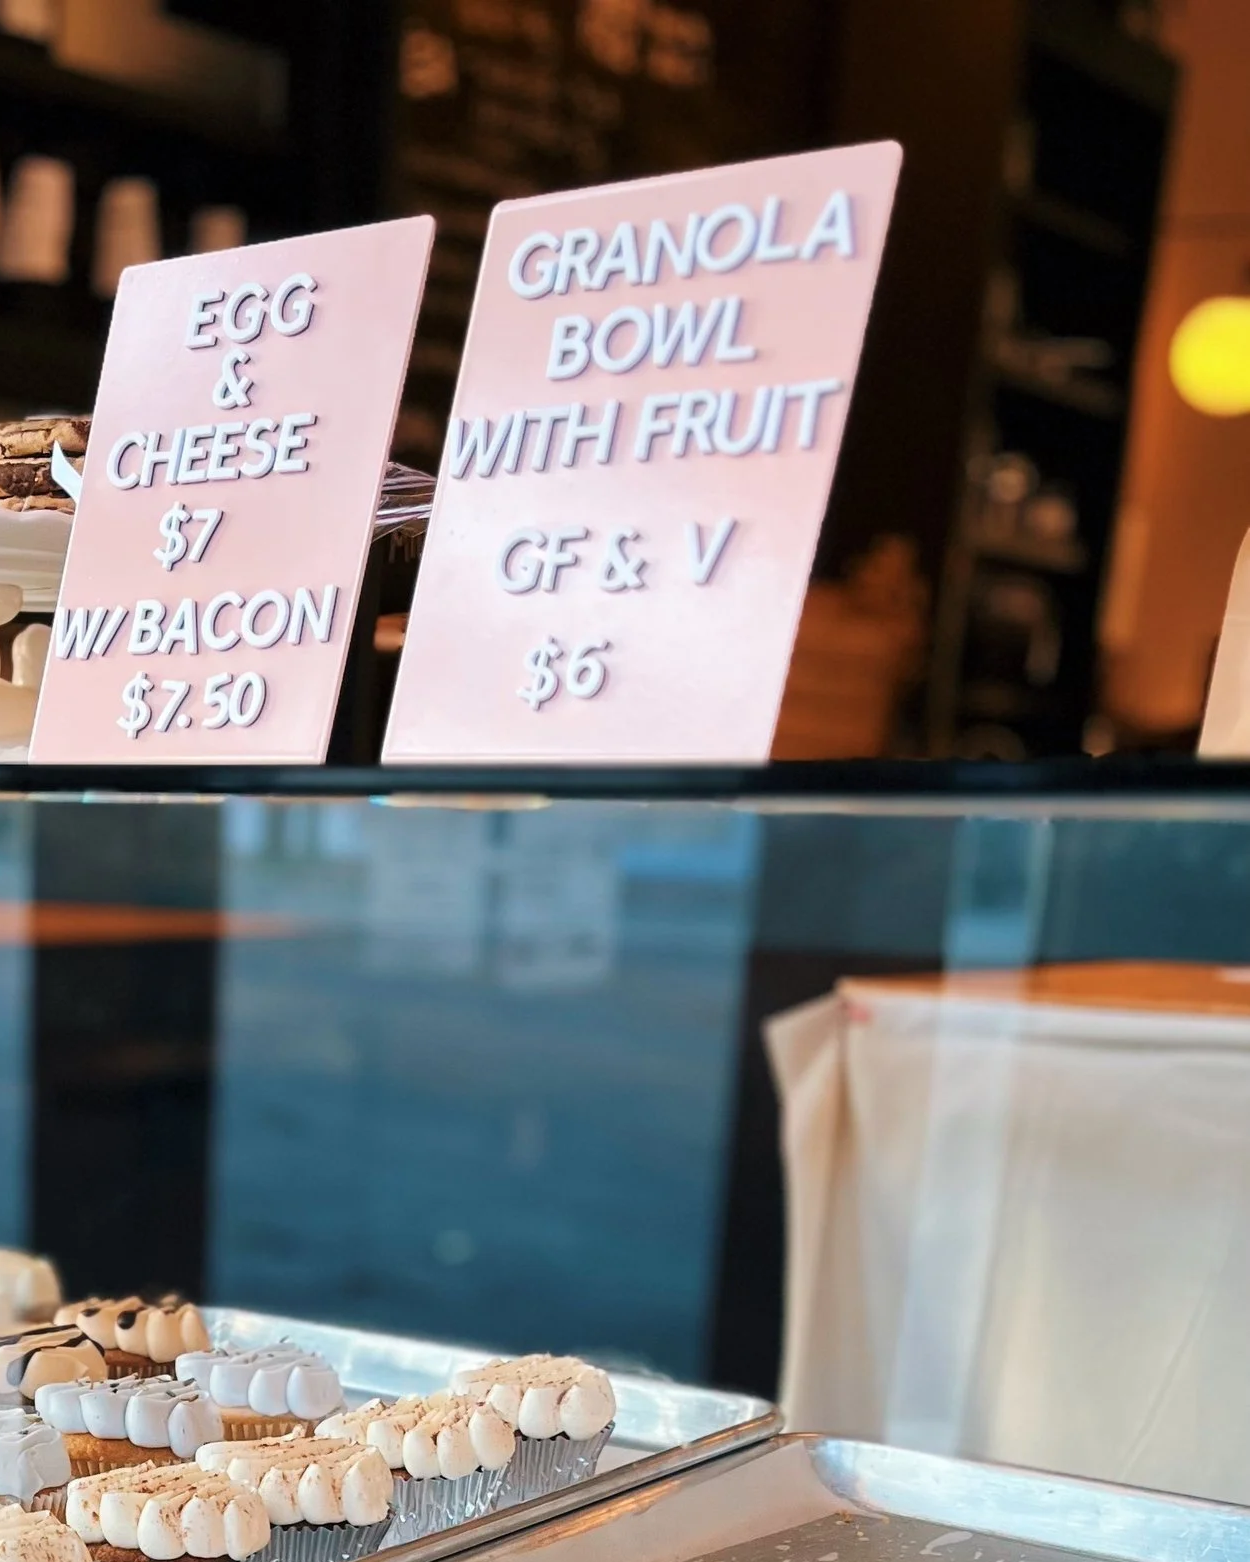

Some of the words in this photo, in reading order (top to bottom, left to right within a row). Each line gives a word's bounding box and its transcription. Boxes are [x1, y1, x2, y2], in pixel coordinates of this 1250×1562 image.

[507, 191, 856, 300] GRANOLA
[184, 273, 318, 350] EGG
[545, 295, 756, 381] BOWL
[212, 349, 255, 411] &
[106, 412, 318, 491] CHEESE
[448, 402, 623, 482] WITH
[634, 378, 845, 464] FRUIT
[153, 502, 224, 571] $7
[494, 524, 588, 595] GF
[600, 528, 647, 591] &
[683, 518, 737, 588] V
[54, 606, 126, 660] W/
[127, 585, 340, 656] BACON
[117, 670, 266, 738] $7.50
[517, 636, 612, 711] $6
